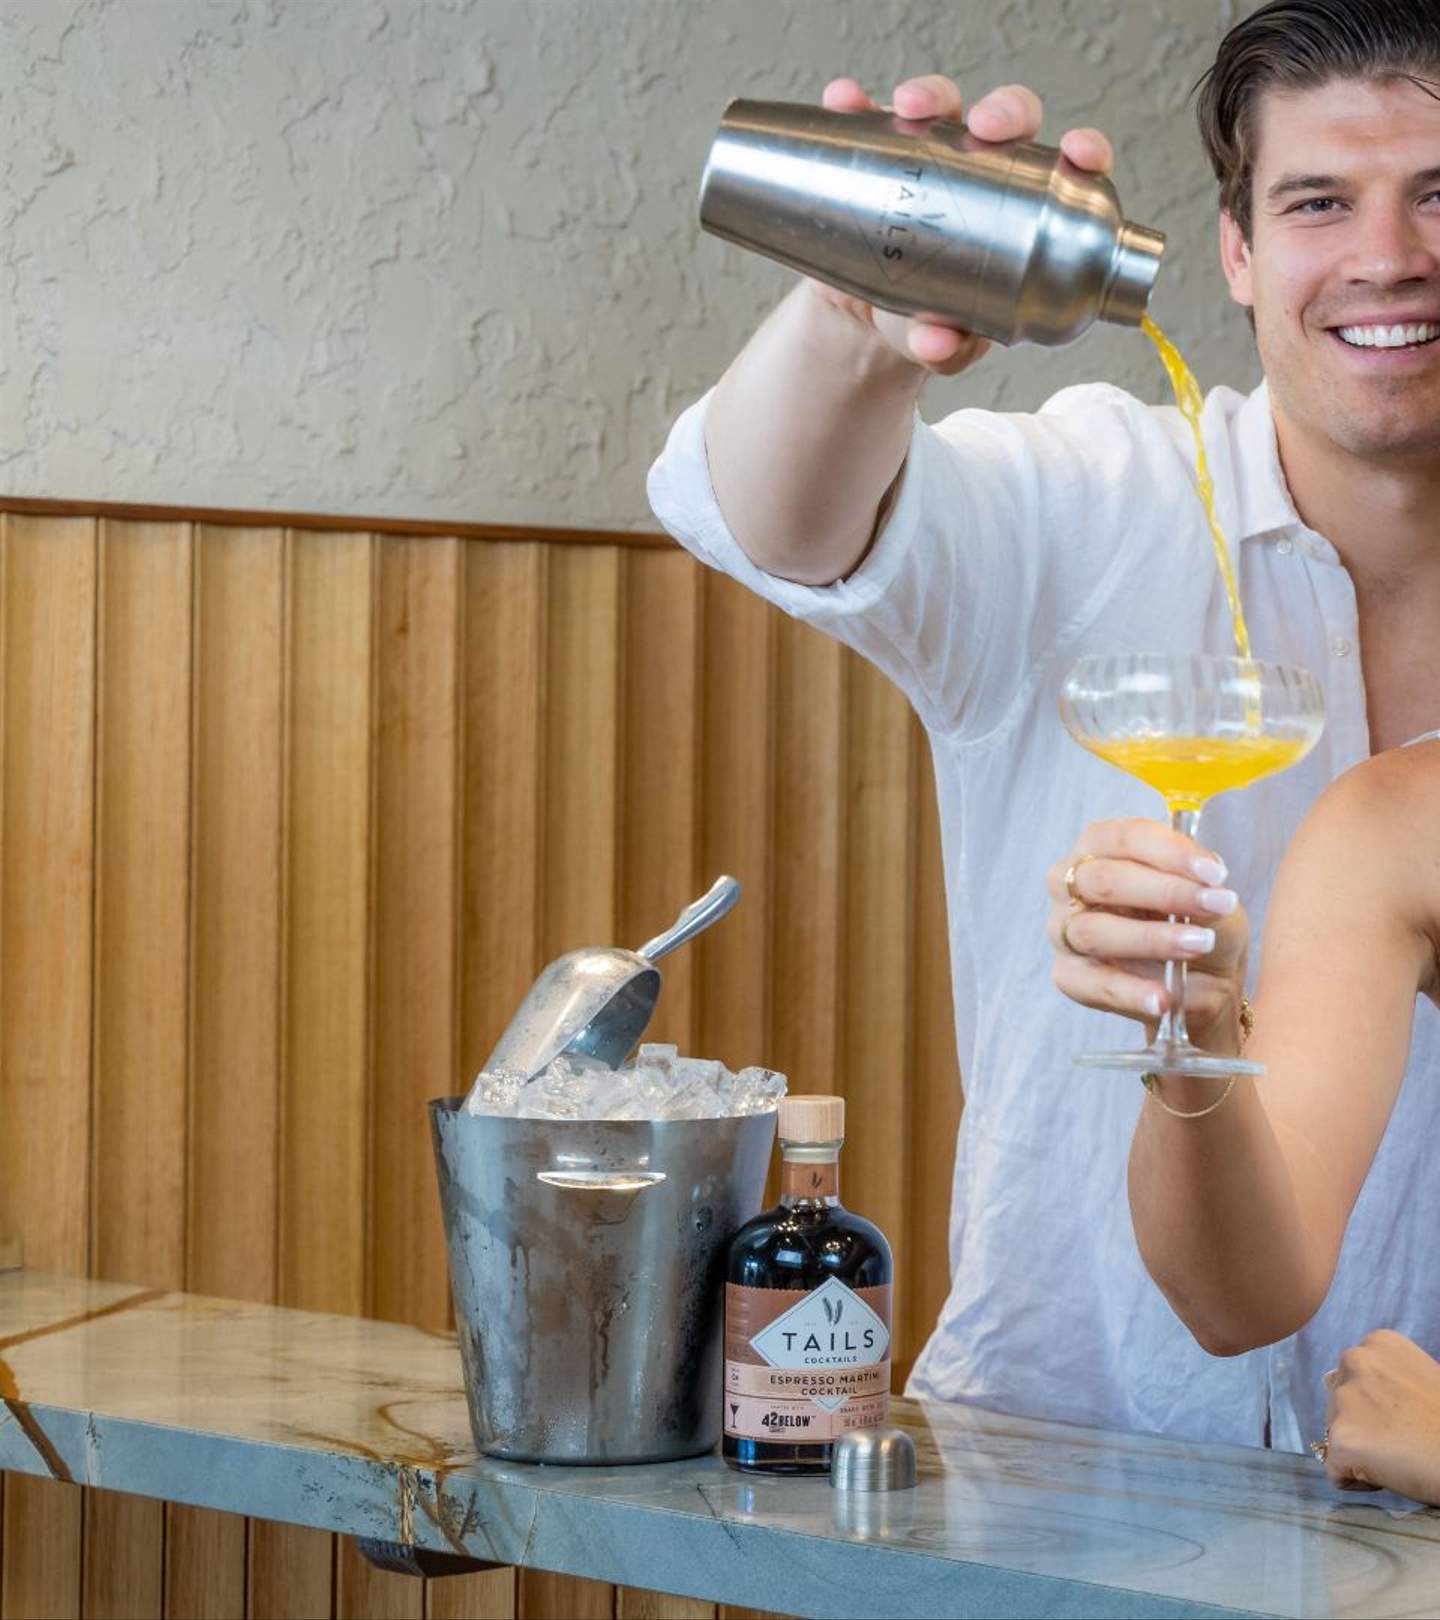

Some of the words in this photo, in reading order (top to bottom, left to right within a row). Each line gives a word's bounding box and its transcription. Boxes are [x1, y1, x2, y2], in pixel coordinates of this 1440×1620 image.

[883, 167, 923, 261] TAILS
[781, 1329, 875, 1351] TAILS
[804, 1355, 858, 1364] COCKTAILS
[770, 1374, 835, 1385] ESPRESSO
[801, 1386, 857, 1396] COCKTAIL
